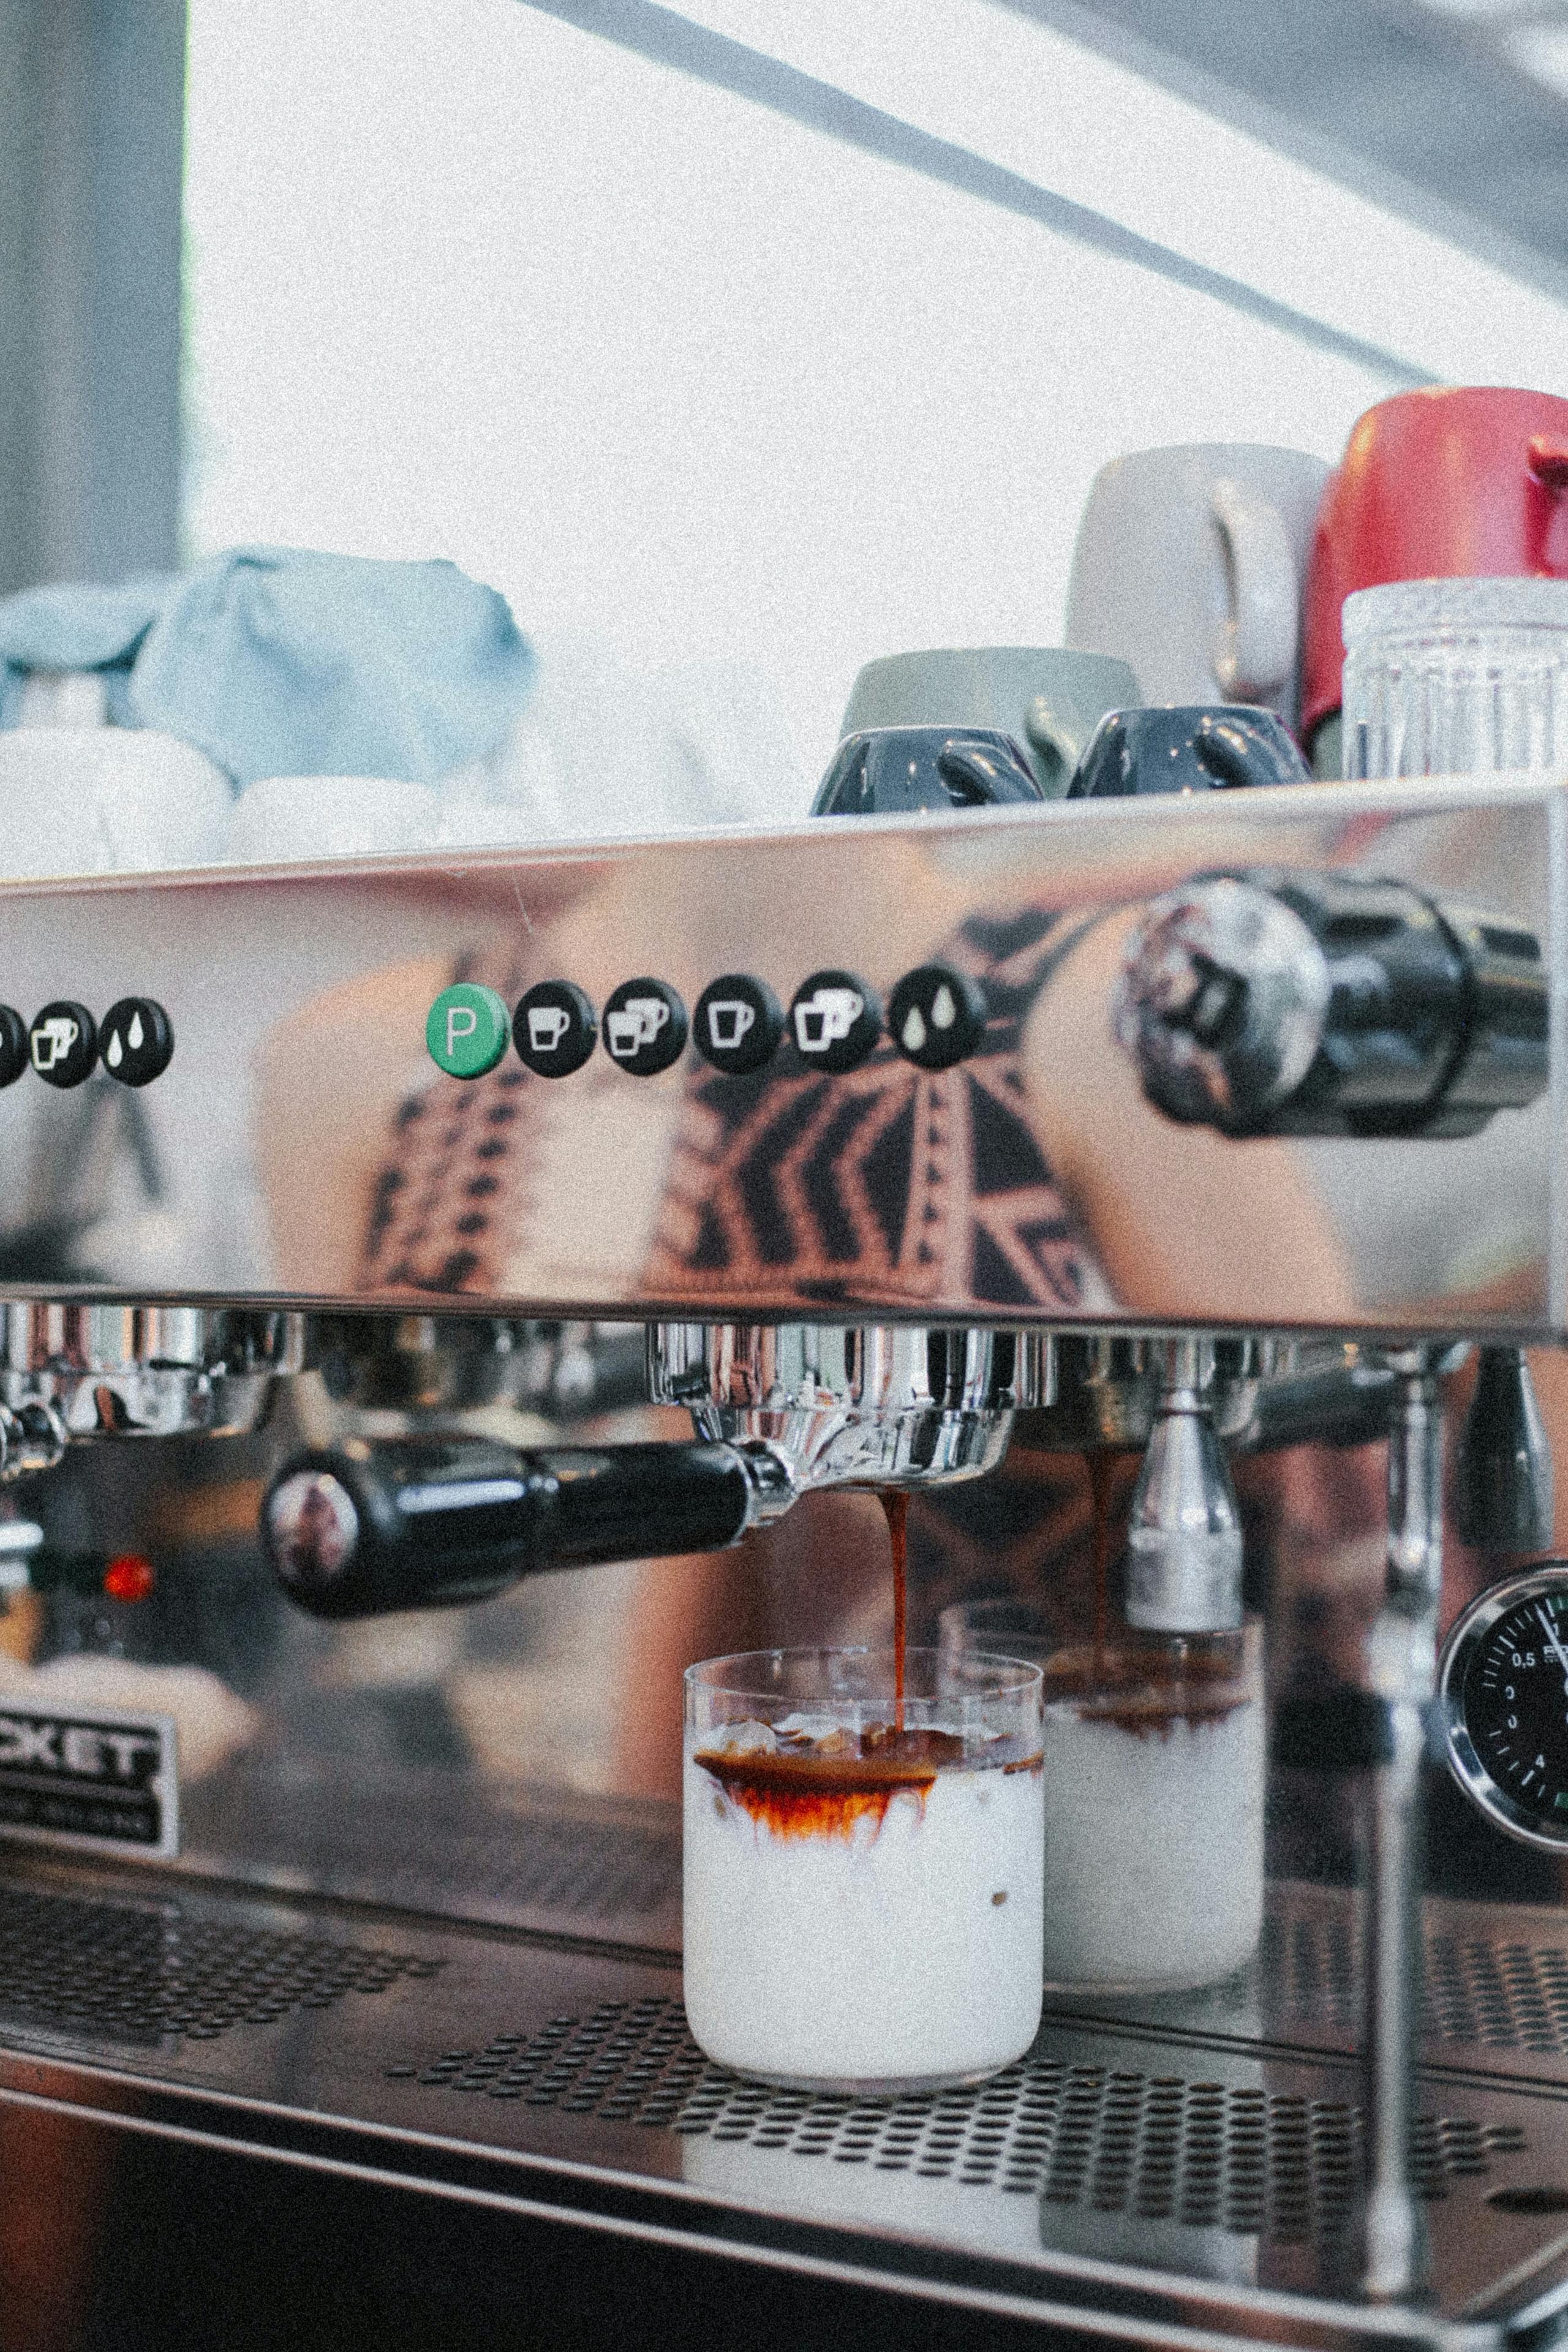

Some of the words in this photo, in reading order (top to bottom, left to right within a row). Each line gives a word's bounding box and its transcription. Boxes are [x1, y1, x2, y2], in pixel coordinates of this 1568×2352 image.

[447, 1006, 477, 1055] P
[1512, 1652, 1536, 1669] 0,5
[1535, 1754, 1545, 1768] 4
